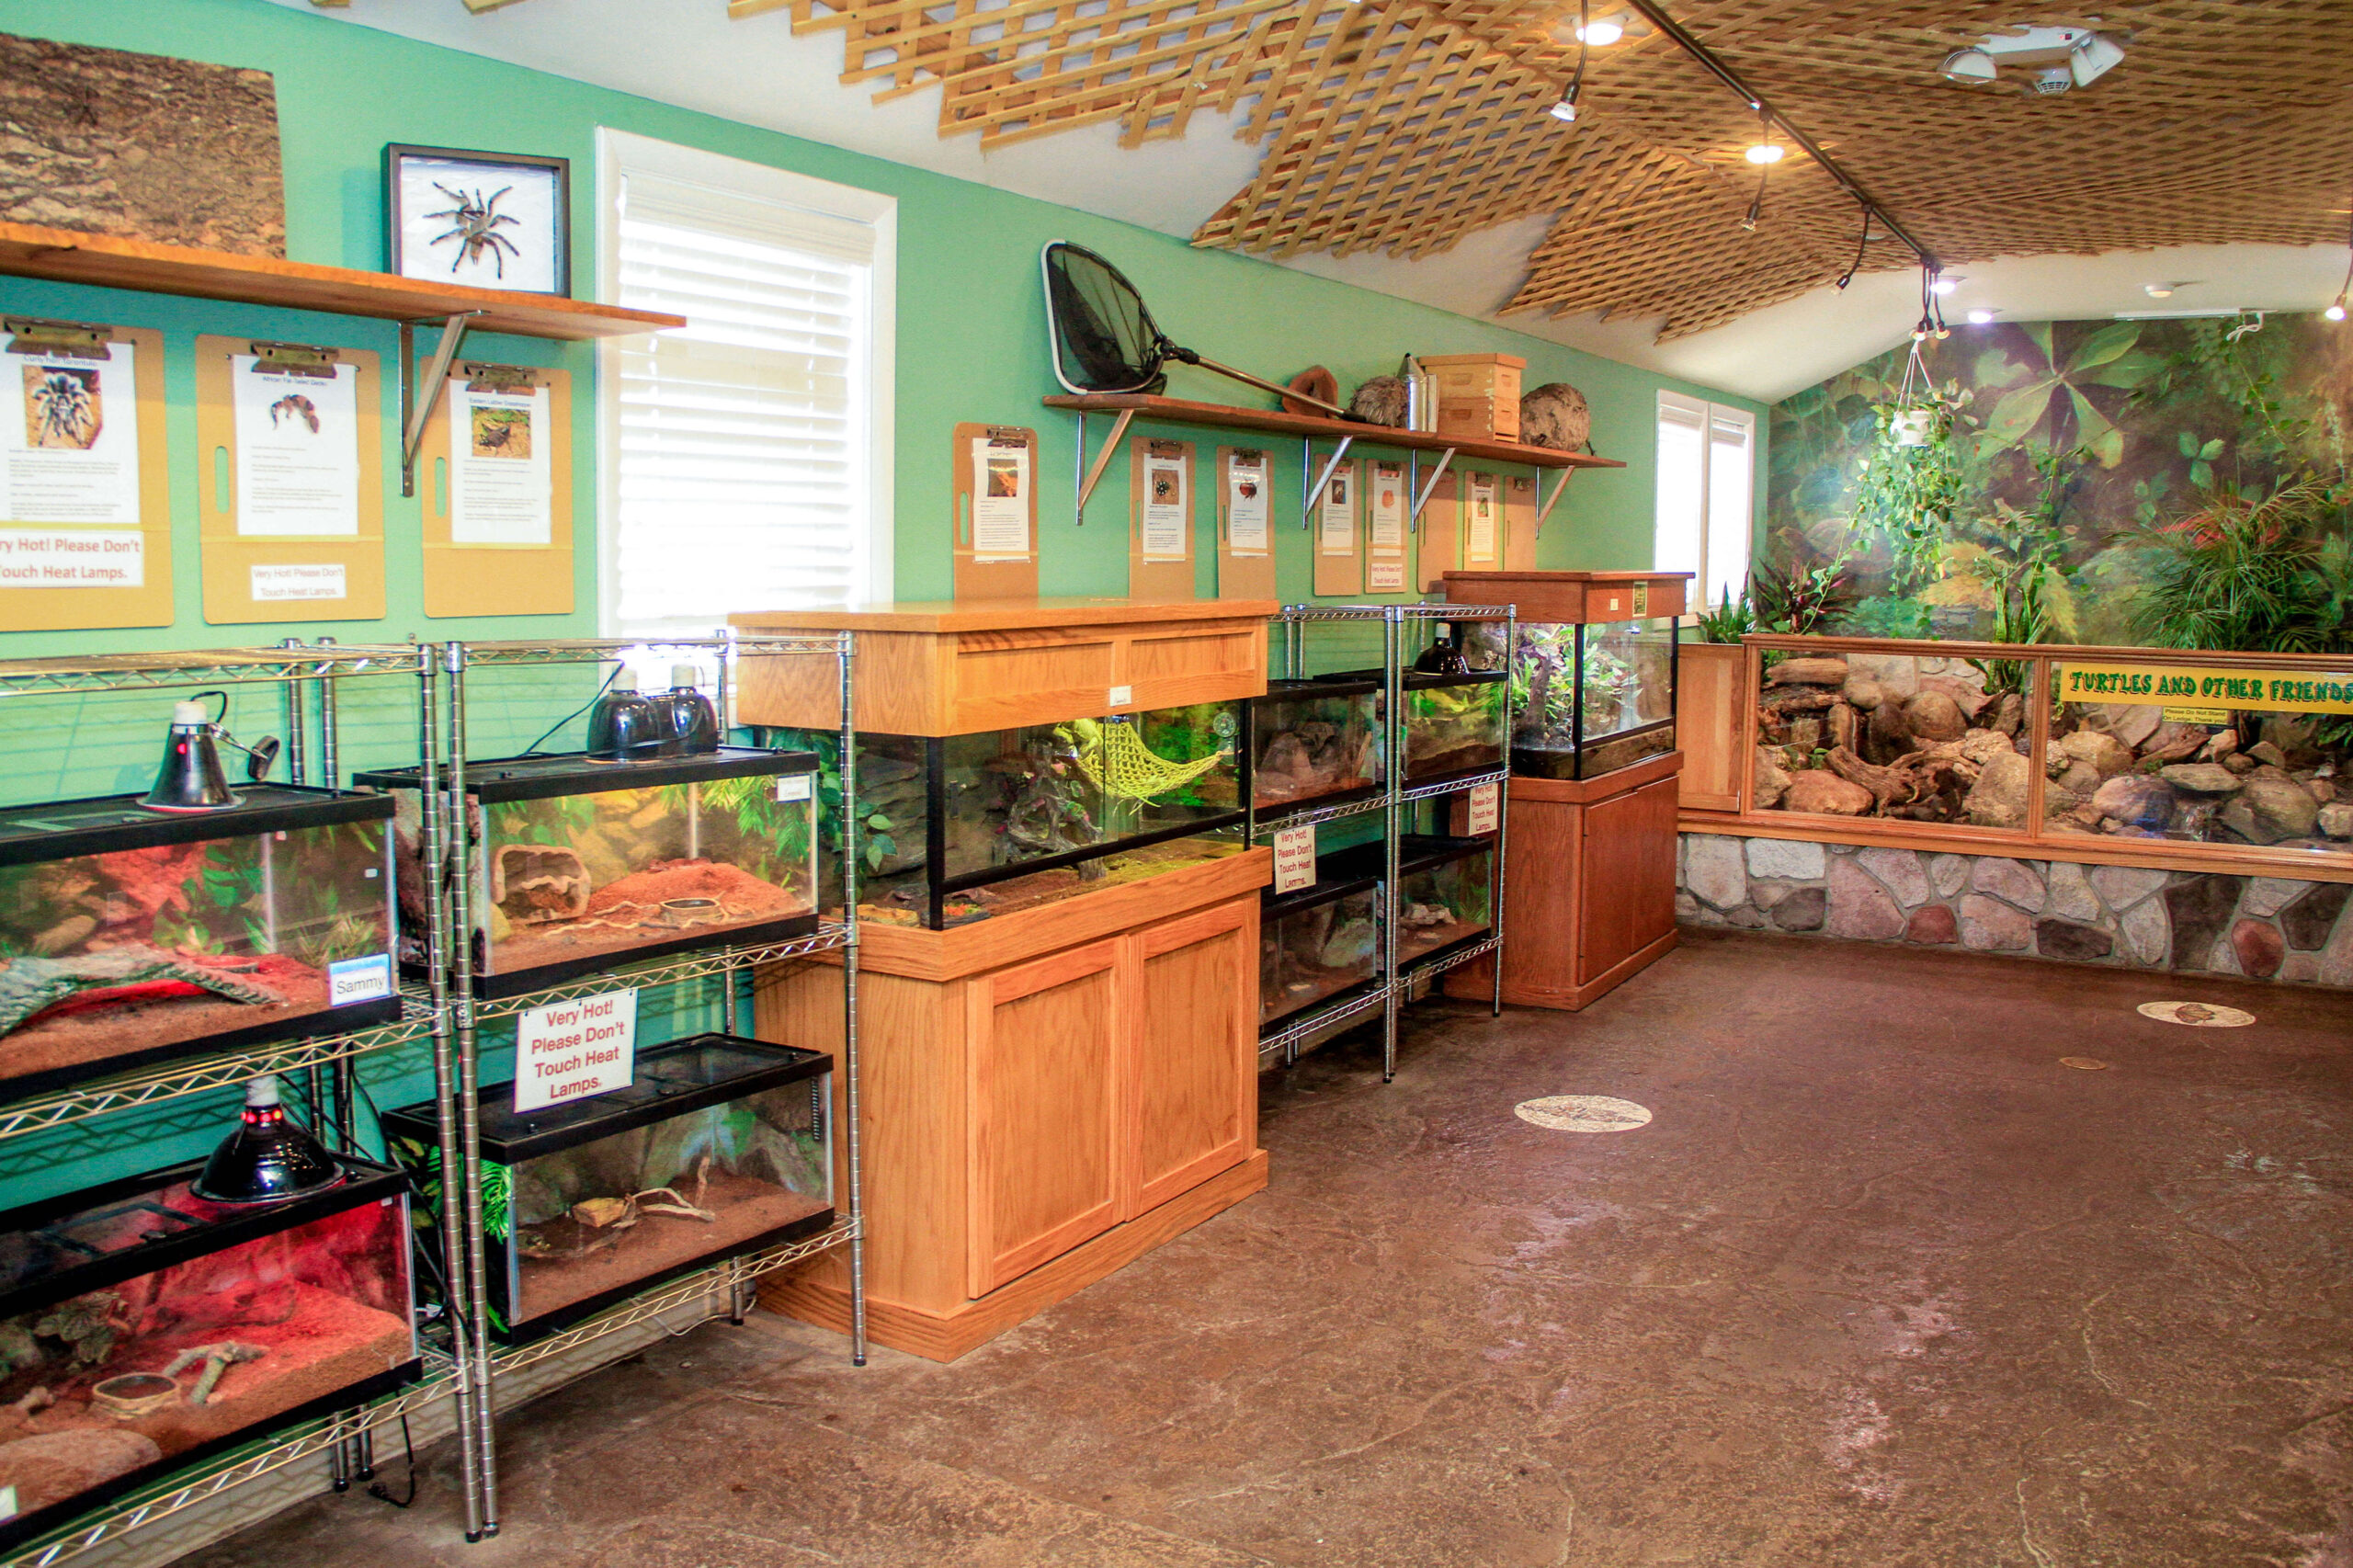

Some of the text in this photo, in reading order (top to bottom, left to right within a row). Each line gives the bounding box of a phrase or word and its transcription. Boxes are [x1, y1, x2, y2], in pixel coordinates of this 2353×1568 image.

[0, 538, 140, 553] ry Hot! Please Don't
[0, 564, 128, 581] ouch Heat Lamps.
[294, 568, 320, 577] Please
[261, 587, 287, 597] Touch
[2070, 671, 2353, 704] TURTLES AND OTHER FRIENDS
[1280, 829, 1307, 843] Very Hot!
[1278, 844, 1313, 859] Please Don't
[1279, 859, 1312, 874] Touch Heat
[336, 976, 385, 994] Sammy
[546, 999, 614, 1027] Very Hot!
[531, 1021, 625, 1054] Please Don't
[535, 1046, 620, 1078] Touch Heat
[550, 1076, 604, 1099] Lamps.
